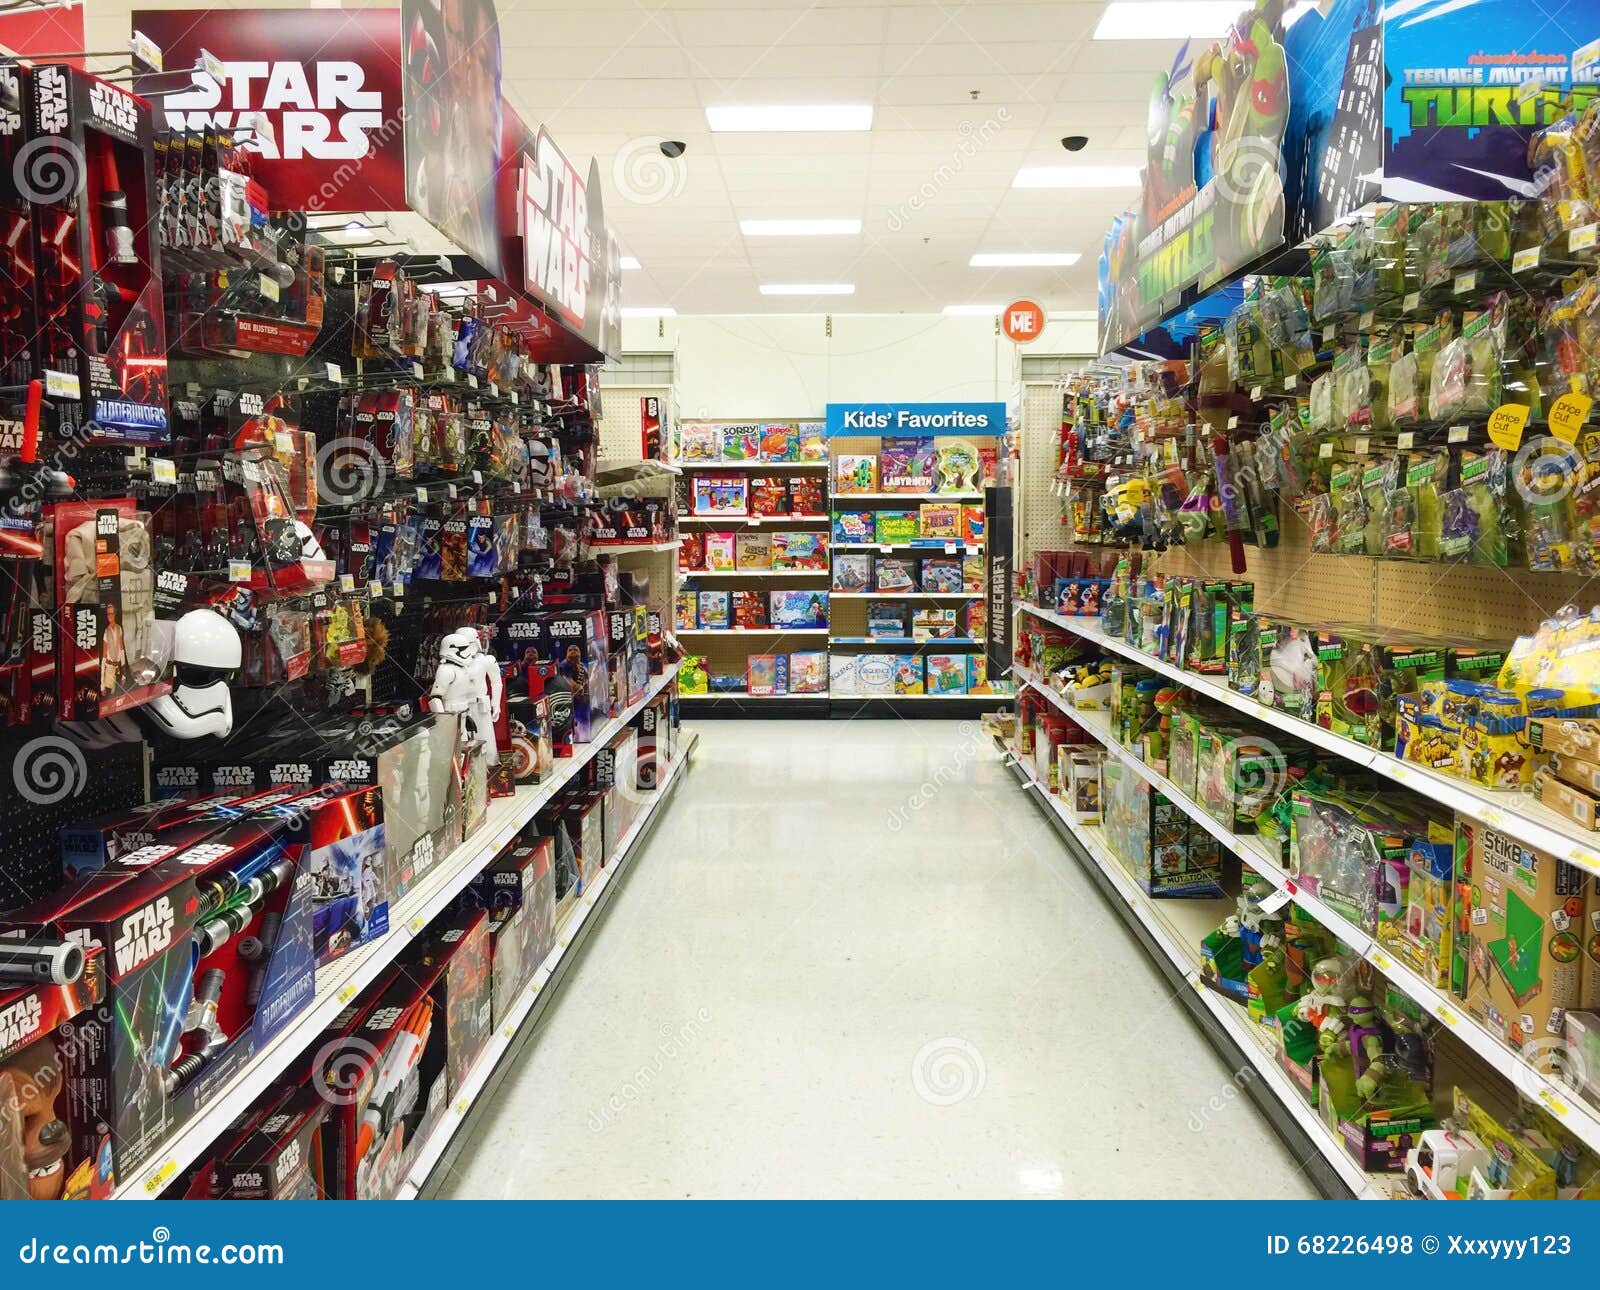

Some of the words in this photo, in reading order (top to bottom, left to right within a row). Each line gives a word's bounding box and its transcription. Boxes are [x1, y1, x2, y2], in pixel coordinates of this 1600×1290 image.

[1468, 50, 1567, 65] nickelodeon
[1404, 66, 1484, 84] TEENAGE
[163, 61, 382, 110] STAR
[38, 67, 53, 134] WARS
[51, 66, 69, 134] STAR
[94, 82, 138, 115] STAR
[90, 96, 138, 133] WARS
[164, 111, 382, 160] WARS
[527, 134, 591, 257] STAR
[527, 199, 591, 320] WARS
[239, 322, 252, 331] BOX
[253, 324, 279, 335] BUSTERS
[1011, 315, 1034, 333] ME
[240, 393, 264, 405] STAR
[239, 404, 264, 416] WARS
[1556, 402, 1581, 416] price
[898, 411, 988, 428] Favorites
[1495, 412, 1520, 424] price
[1553, 411, 1570, 423] cut
[723, 425, 759, 436] SORRY!
[1493, 422, 1510, 431] cut
[99, 514, 118, 525] STAR
[98, 524, 118, 535] WARS
[157, 571, 188, 586] STAR
[157, 578, 187, 592] WARS
[992, 555, 1006, 645] MINECRAFT
[76, 609, 86, 649] WARS
[86, 609, 96, 649] STAR
[508, 622, 541, 630] STAR
[550, 620, 583, 629] STAR
[550, 627, 582, 636] WARS
[33, 614, 42, 653] WARS
[42, 613, 53, 653] STAR
[508, 629, 541, 638] WARS
[1394, 656, 1437, 669] TURTLES
[157, 766, 199, 778] STAR
[213, 766, 255, 778] STAR
[270, 764, 312, 774] STAR
[329, 760, 370, 770] STAR
[157, 776, 199, 786] WARS
[212, 776, 254, 786] WARS
[270, 773, 312, 783] WARS
[329, 769, 370, 779] WARS
[1484, 830, 1539, 873] StikBot
[122, 896, 174, 937] STAR
[115, 921, 175, 977] WARS
[0, 994, 42, 1030] STAR
[0, 1008, 42, 1051] WARS
[278, 1138, 300, 1168] STAR
[276, 1151, 300, 1184] WARS
[232, 1179, 264, 1187] WARS
